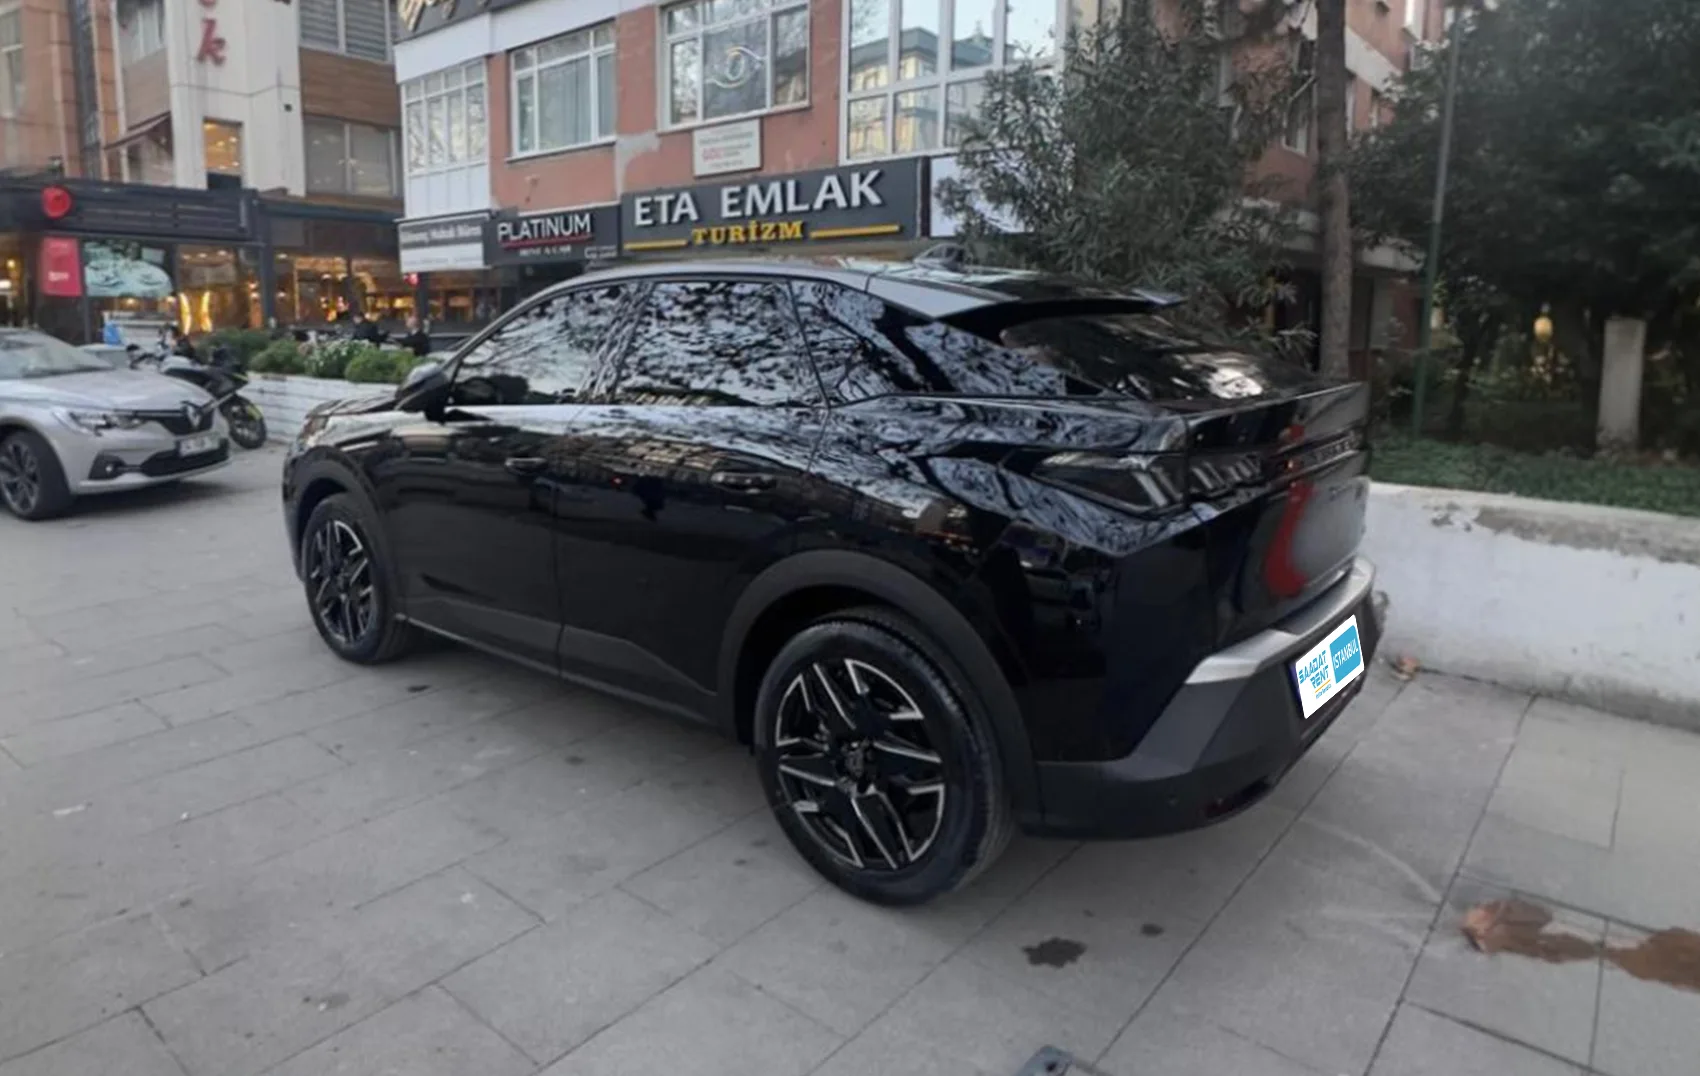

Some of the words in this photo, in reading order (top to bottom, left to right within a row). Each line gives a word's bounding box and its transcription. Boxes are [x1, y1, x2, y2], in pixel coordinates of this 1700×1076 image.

[634, 192, 699, 226] ETA
[721, 169, 882, 218] EMLAK
[497, 212, 591, 243] PLATINUM
[692, 220, 804, 245] TURİZM
